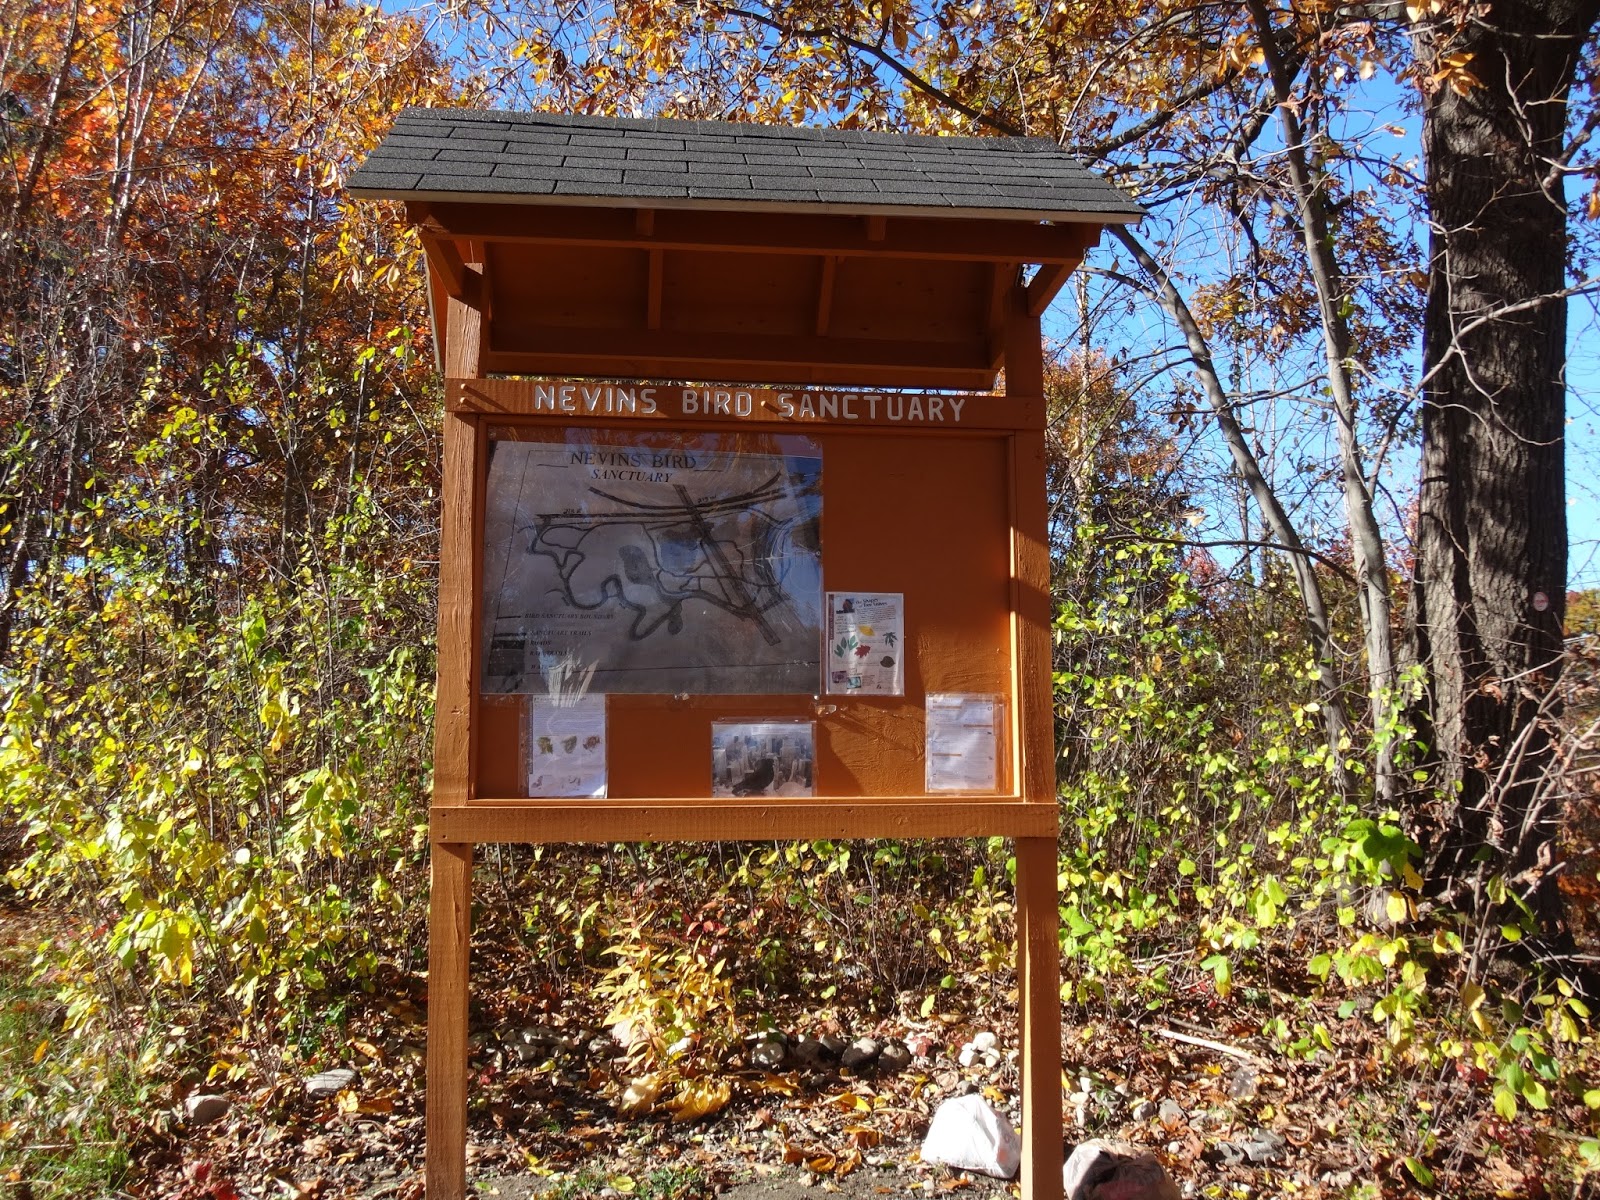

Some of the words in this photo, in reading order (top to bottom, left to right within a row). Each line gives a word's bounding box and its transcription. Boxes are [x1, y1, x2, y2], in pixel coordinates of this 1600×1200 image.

[533, 384, 658, 414] NEVINS
[681, 390, 753, 417] BIRD
[777, 392, 966, 422] SANCTUARY
[570, 451, 642, 468] NEVINS
[651, 454, 697, 469] BIRD
[591, 468, 673, 483] SANCTUARY
